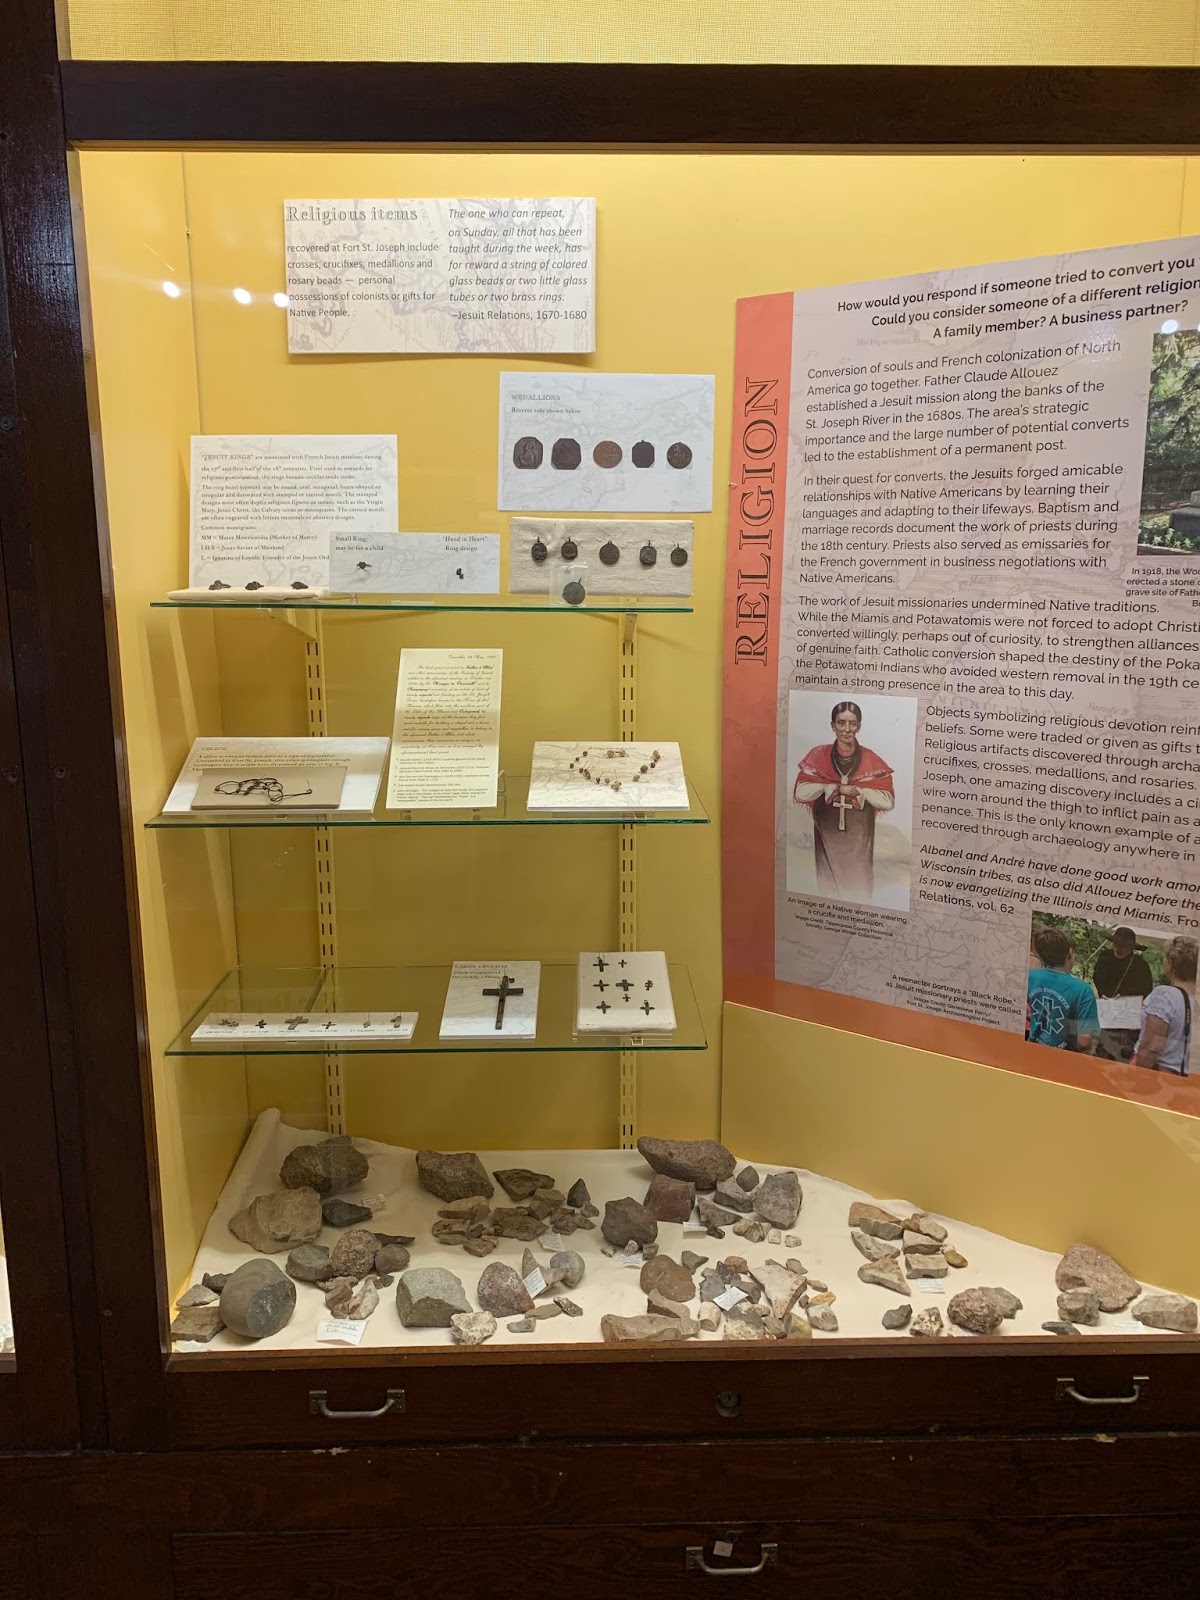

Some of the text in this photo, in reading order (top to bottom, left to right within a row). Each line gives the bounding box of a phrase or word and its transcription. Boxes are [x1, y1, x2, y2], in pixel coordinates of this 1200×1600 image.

[286, 205, 418, 225] Religious items
[449, 209, 466, 218] The
[488, 209, 508, 218] who
[531, 210, 565, 220] repeat,
[463, 228, 499, 239] Sunday,
[502, 228, 514, 236] all
[517, 228, 536, 236] that
[539, 228, 555, 236] has
[558, 228, 582, 236] been
[287, 244, 329, 252] recovered
[342, 243, 360, 251] Fort
[362, 243, 373, 251] St.
[376, 243, 405, 253] Joseph
[408, 243, 439, 251] include
[288, 260, 433, 270] crosses, crucifixes, medallions and
[838, 258, 1195, 311] How would you respond if someone tried to convert you
[319, 309, 350, 318] People.
[452, 310, 587, 321] –Jesuit Relations, 1670-1680
[872, 312, 906, 326] Could
[908, 312, 929, 325] you
[932, 304, 986, 319] consider
[988, 298, 1048, 313] someone
[1052, 292, 1066, 305] of
[1068, 294, 1076, 304] a
[1080, 284, 1142, 302] different
[933, 300, 1188, 338] A family member? A business partner?
[807, 340, 1120, 378] Conversion of souls and French colonization of North
[735, 376, 778, 666] RELIGION
[800, 571, 895, 583] Native Americans.
[1126, 589, 1150, 597] grave
[798, 596, 1159, 613] The work of Jesuit missionaries undermined Native traditions.
[795, 674, 1074, 702] maintain a strong presence in the area to this day.
[926, 706, 972, 719] Objects
[973, 711, 1046, 726] symbolizing
[1050, 715, 1104, 729] religious
[1108, 719, 1166, 733] devotion
[797, 899, 817, 909] image
[818, 903, 825, 911] of
[826, 904, 831, 912] a
[832, 905, 853, 914] Native
[854, 910, 878, 919] woman
[880, 914, 907, 925] wearing
[919, 890, 1014, 914] Relations, vol. 62
[812, 910, 836, 918] crucifix
[892, 974, 897, 983] A
[898, 976, 931, 987] reenactor
[932, 983, 961, 994] portrays
[968, 990, 992, 1000] "Black
[993, 995, 1016, 1005] Robe,"
[894, 983, 914, 992] Jesuit
[915, 988, 952, 1001] missionary
[953, 996, 978, 1006] priests
[978, 1002, 997, 1010] were
[998, 1005, 1022, 1015] called.
